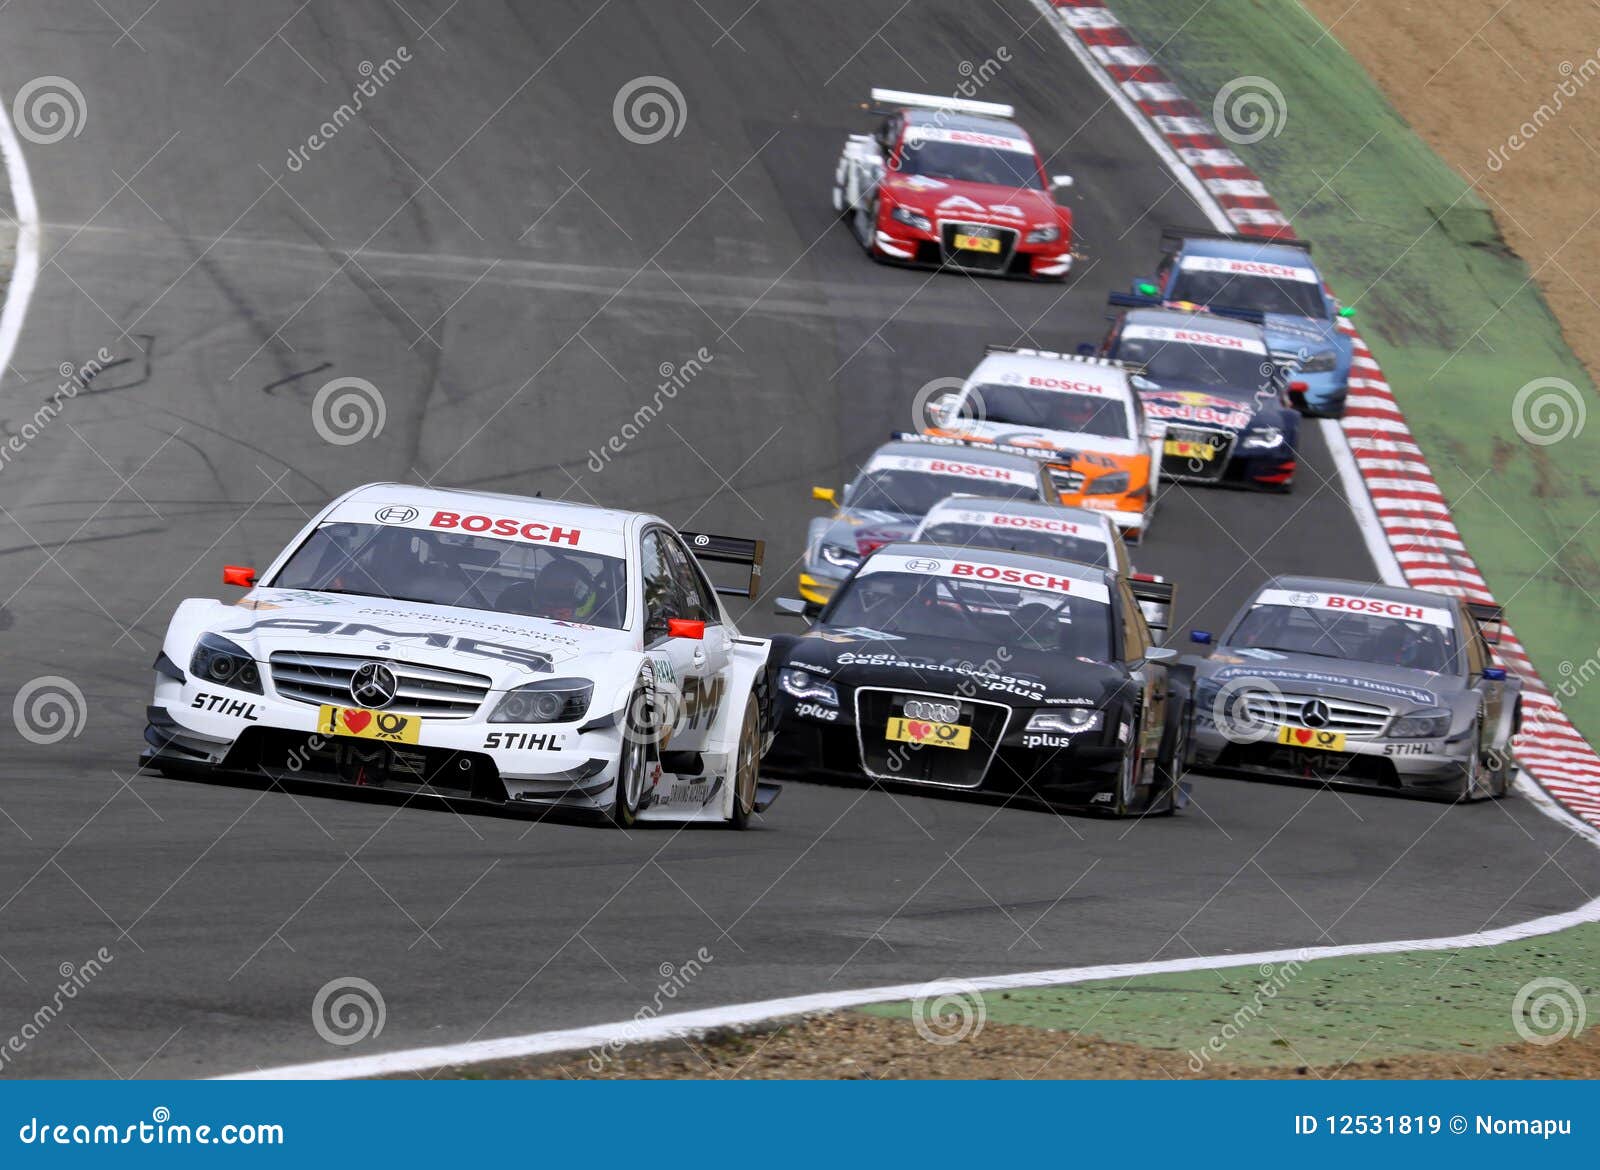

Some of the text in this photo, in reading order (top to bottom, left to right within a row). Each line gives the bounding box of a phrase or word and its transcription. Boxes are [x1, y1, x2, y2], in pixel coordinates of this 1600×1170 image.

[1230, 262, 1297, 278] BOSCH
[1174, 331, 1243, 348] BOSCH
[1028, 376, 1103, 394] BOSCH
[1143, 401, 1252, 429] Red Bull
[930, 460, 1011, 480] BOSCH
[429, 510, 581, 546] BOSCH
[993, 515, 1080, 534] BOSCH
[950, 562, 1071, 592] BOSCH
[1326, 595, 1424, 620] BOSCH
[419, 616, 576, 645] PERFORMANCE
[222, 618, 555, 673] AMG
[838, 652, 896, 660] Audi
[836, 658, 1047, 691] Gebrauchtwagen
[983, 681, 1044, 701] :plus
[1222, 667, 1432, 703] Mercedes-Benz Financial
[191, 693, 259, 721] STIHL
[795, 702, 839, 721] :plus
[484, 732, 563, 751] STIHL
[1023, 734, 1069, 748] :plus
[1384, 743, 1433, 756] STIHL
